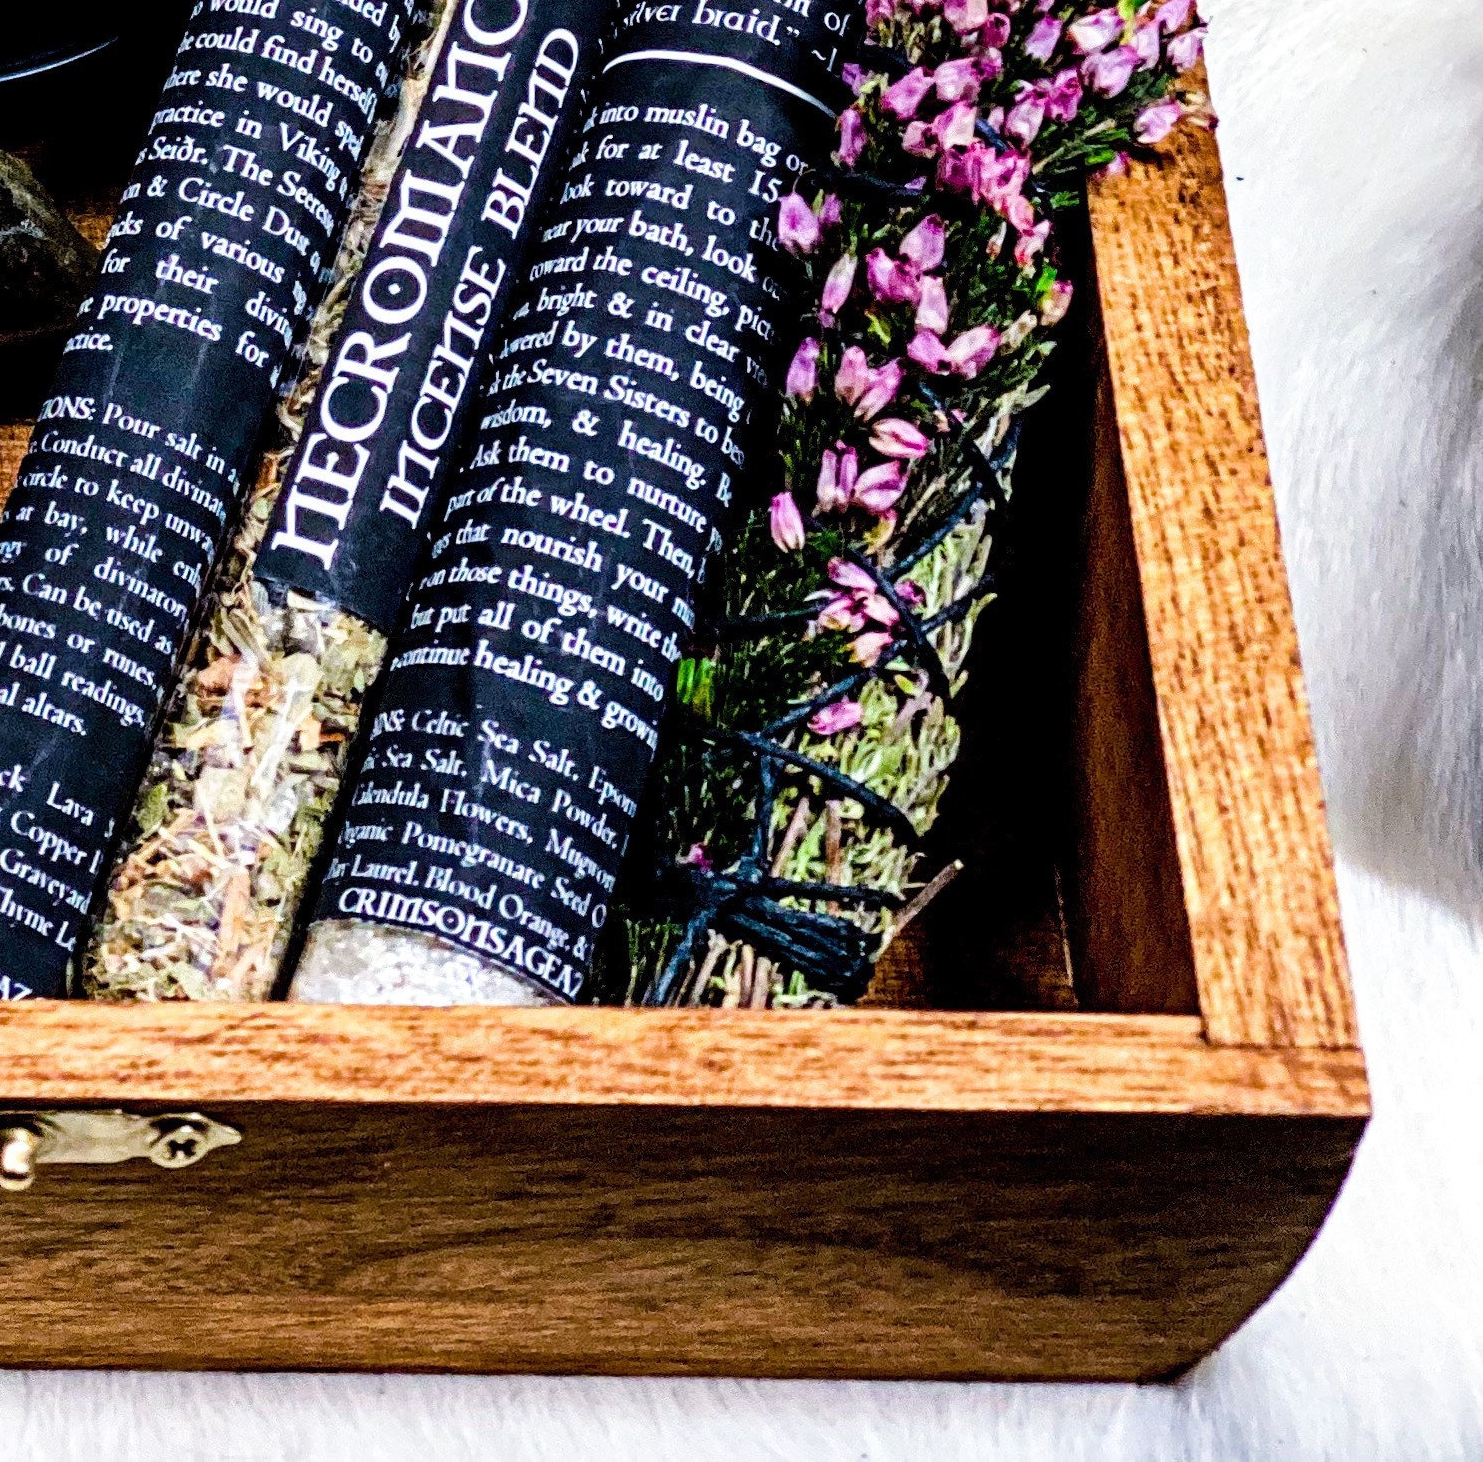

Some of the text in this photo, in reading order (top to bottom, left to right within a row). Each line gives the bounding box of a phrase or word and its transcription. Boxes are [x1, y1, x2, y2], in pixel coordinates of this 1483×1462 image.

[194, 25, 320, 75] could find
[289, 7, 344, 52] sing
[643, 103, 782, 168] muslin bag
[217, 143, 274, 187] The
[672, 139, 736, 184] least
[177, 176, 255, 222] Circle
[604, 179, 694, 210] toward
[200, 231, 286, 284] various
[628, 209, 757, 284] bath, look
[155, 252, 220, 295] their
[379, 28, 604, 530] INCENSE BLEND
[96, 294, 223, 342] properties
[603, 332, 680, 382] them,
[526, 358, 691, 428] Seven Sisters
[101, 402, 162, 439] Pour
[617, 419, 707, 491] healing.
[550, 491, 631, 539] wheel.
[500, 527, 603, 573] nourish
[507, 564, 600, 628] things,
[9, 643, 58, 680] ball
[10, 810, 88, 865] Copper
[401, 820, 545, 889] Pomegranate
[424, 865, 498, 910] Blood
